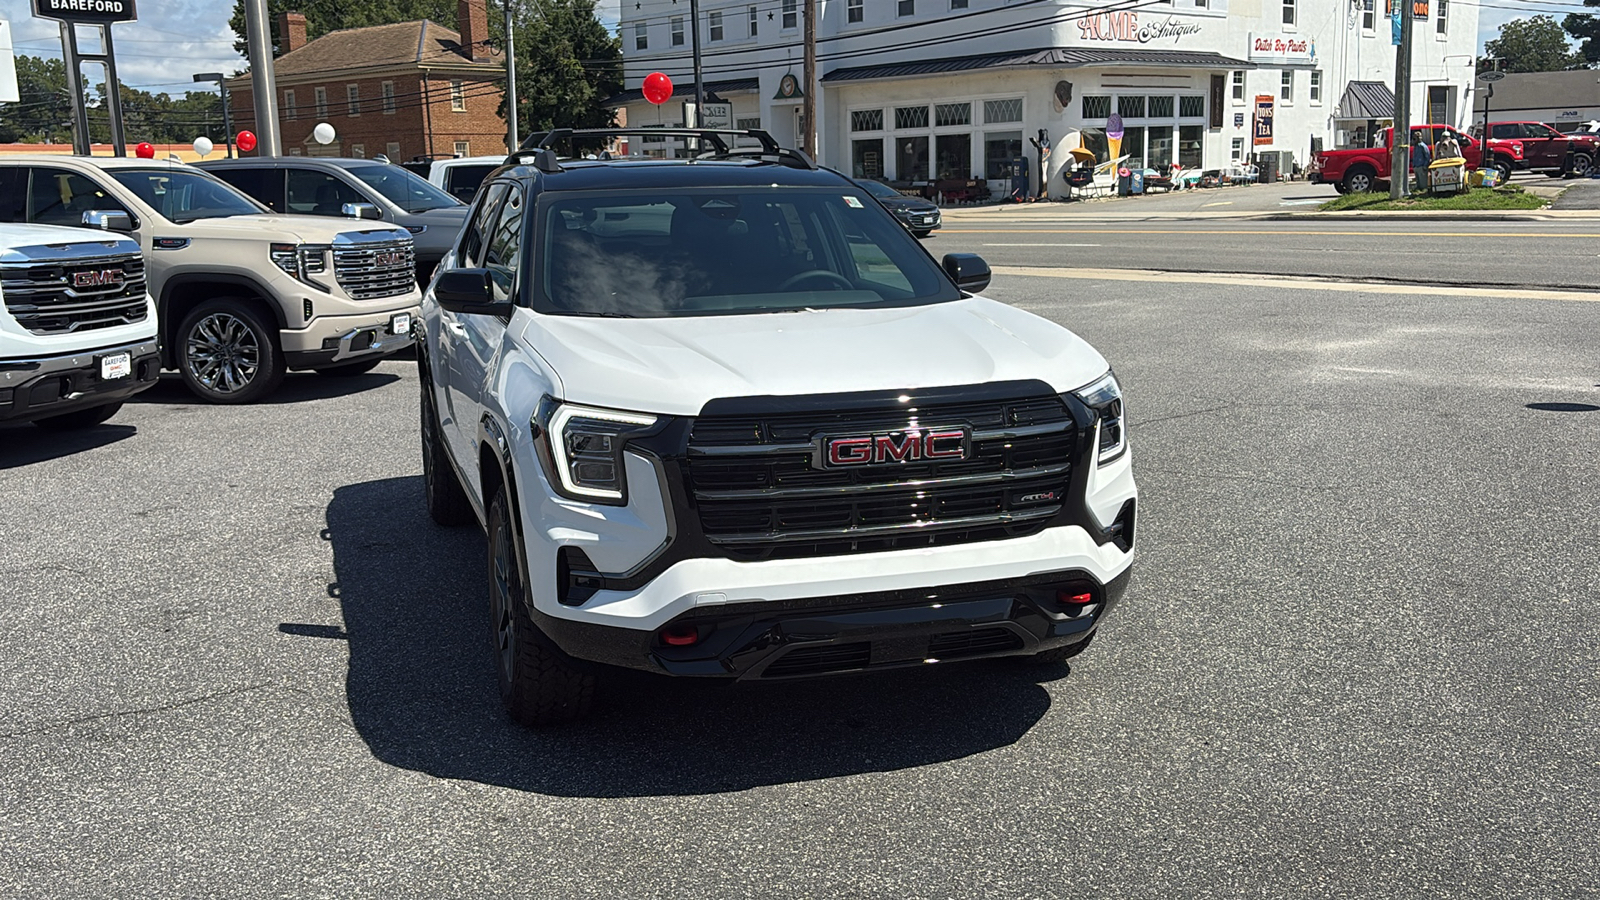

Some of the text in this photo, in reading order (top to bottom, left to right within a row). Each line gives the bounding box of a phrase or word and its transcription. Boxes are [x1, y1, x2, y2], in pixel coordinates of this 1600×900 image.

[50, 0, 123, 13] BAREFORD
[1077, 10, 1202, 44] ACME Antiques
[1255, 37, 1307, 55] Dutch Boy Paints
[1258, 123, 1271, 135] TEA
[73, 268, 124, 287] GMC
[828, 430, 965, 465] GMC
[1021, 492, 1054, 501] AT4
